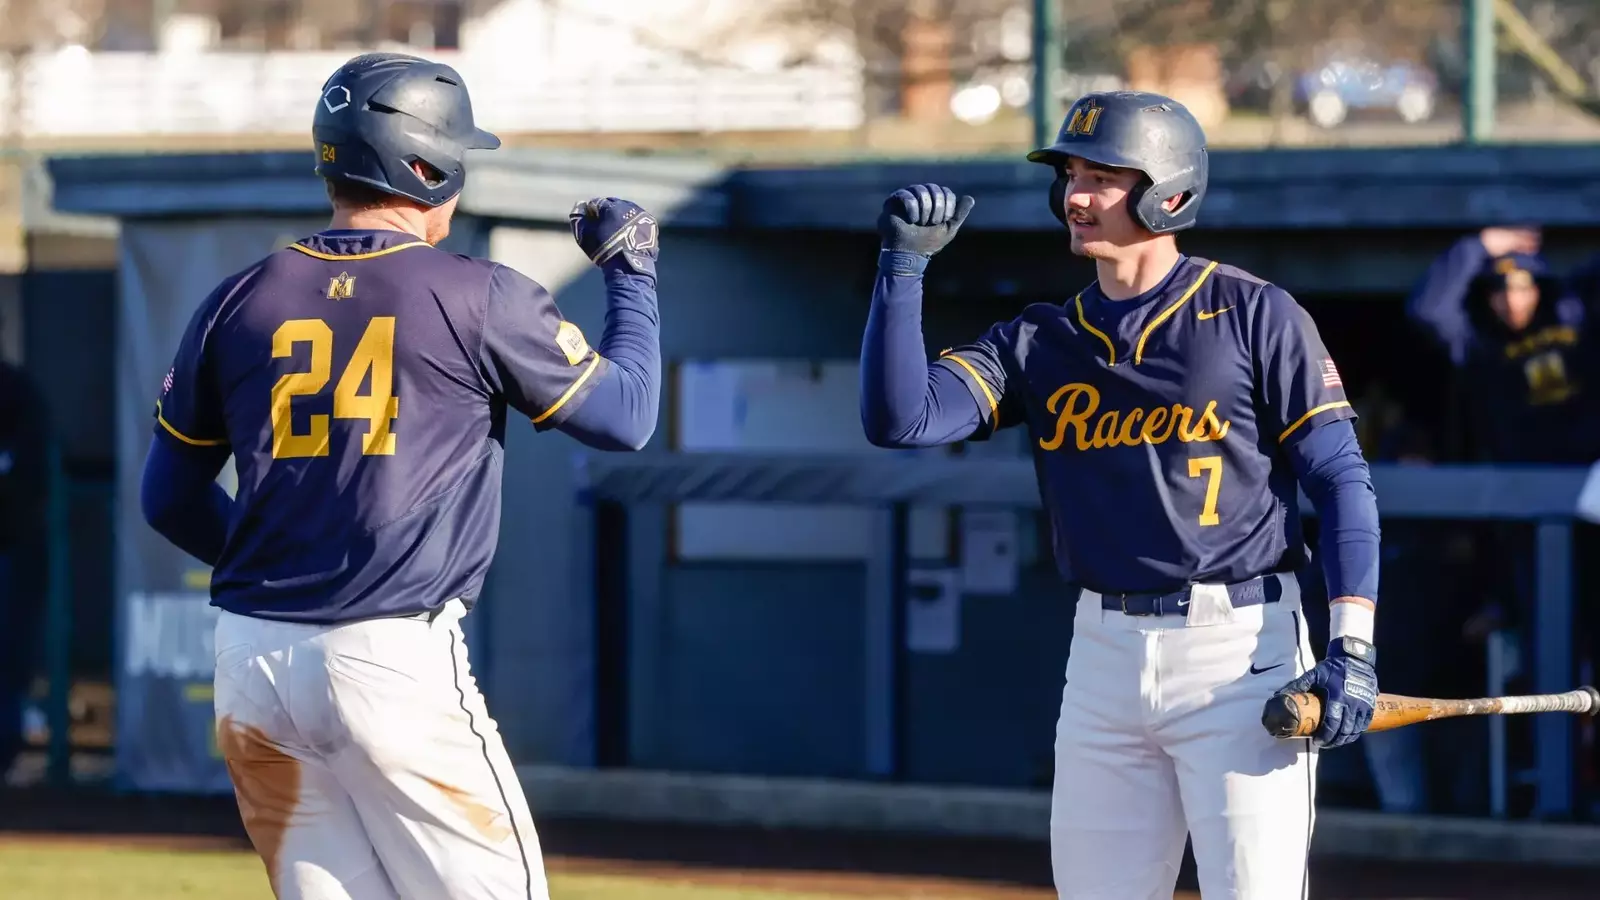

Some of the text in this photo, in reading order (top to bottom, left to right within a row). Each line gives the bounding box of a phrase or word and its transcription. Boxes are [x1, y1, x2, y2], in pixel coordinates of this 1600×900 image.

[1065, 105, 1104, 136] M
[322, 144, 335, 163] 24
[327, 273, 356, 300] M
[271, 316, 399, 459] 24
[1039, 382, 1231, 451] Racers
[1188, 456, 1223, 526] 7
